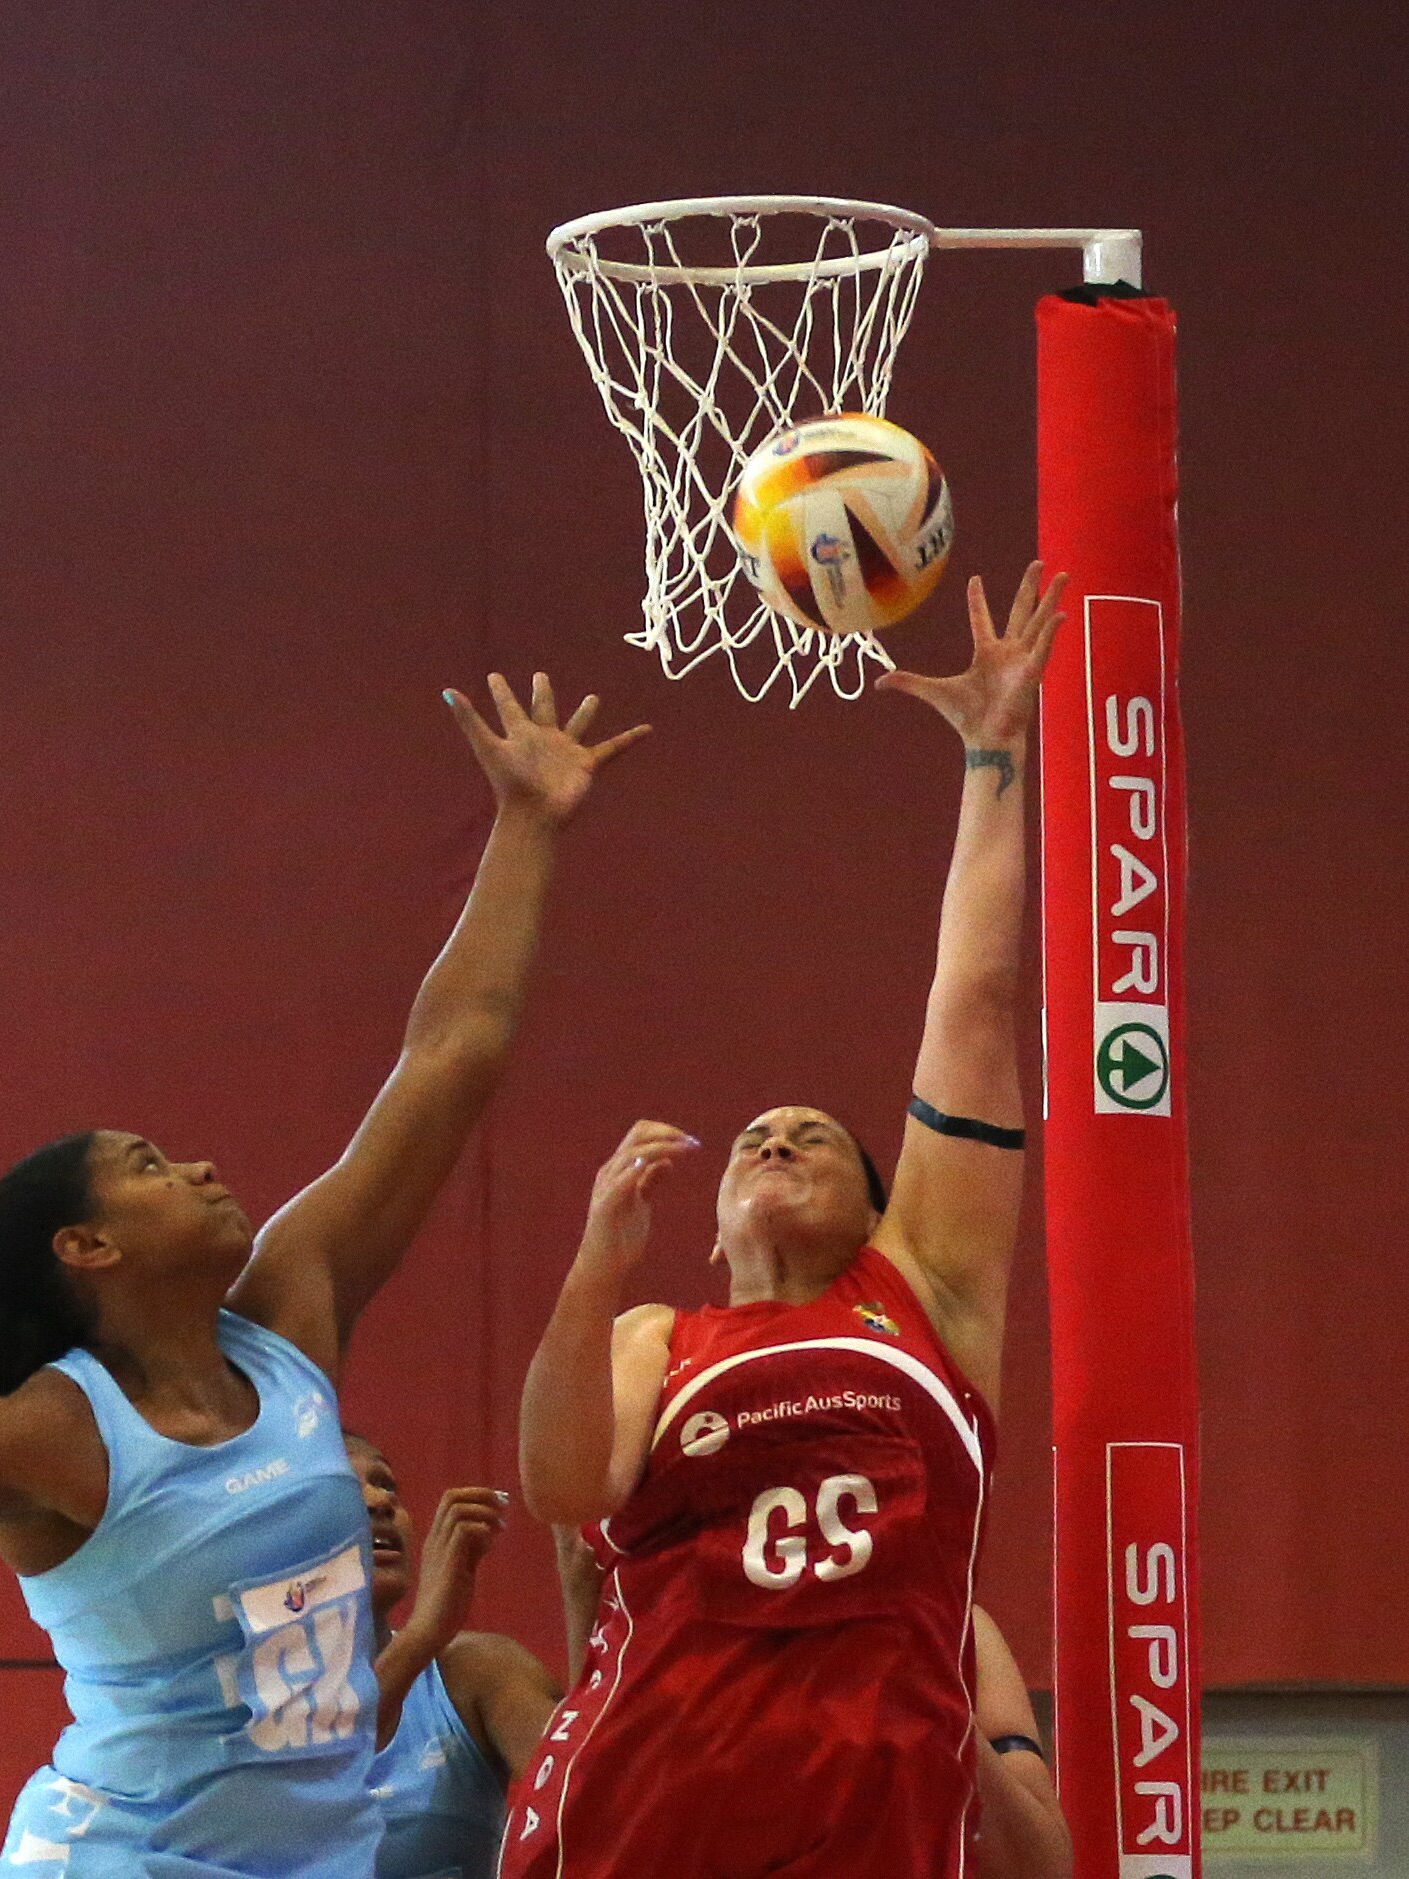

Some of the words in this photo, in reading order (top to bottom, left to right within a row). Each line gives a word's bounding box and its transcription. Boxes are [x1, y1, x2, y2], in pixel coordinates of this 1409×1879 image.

[1105, 693, 1159, 995] SPAR
[742, 1473, 879, 1590] GS
[1125, 1541, 1184, 1847] SPAR
[1202, 1768, 1250, 1794] IRE
[1261, 1768, 1330, 1794] EXIT
[1253, 1807, 1356, 1833] CLEAR
